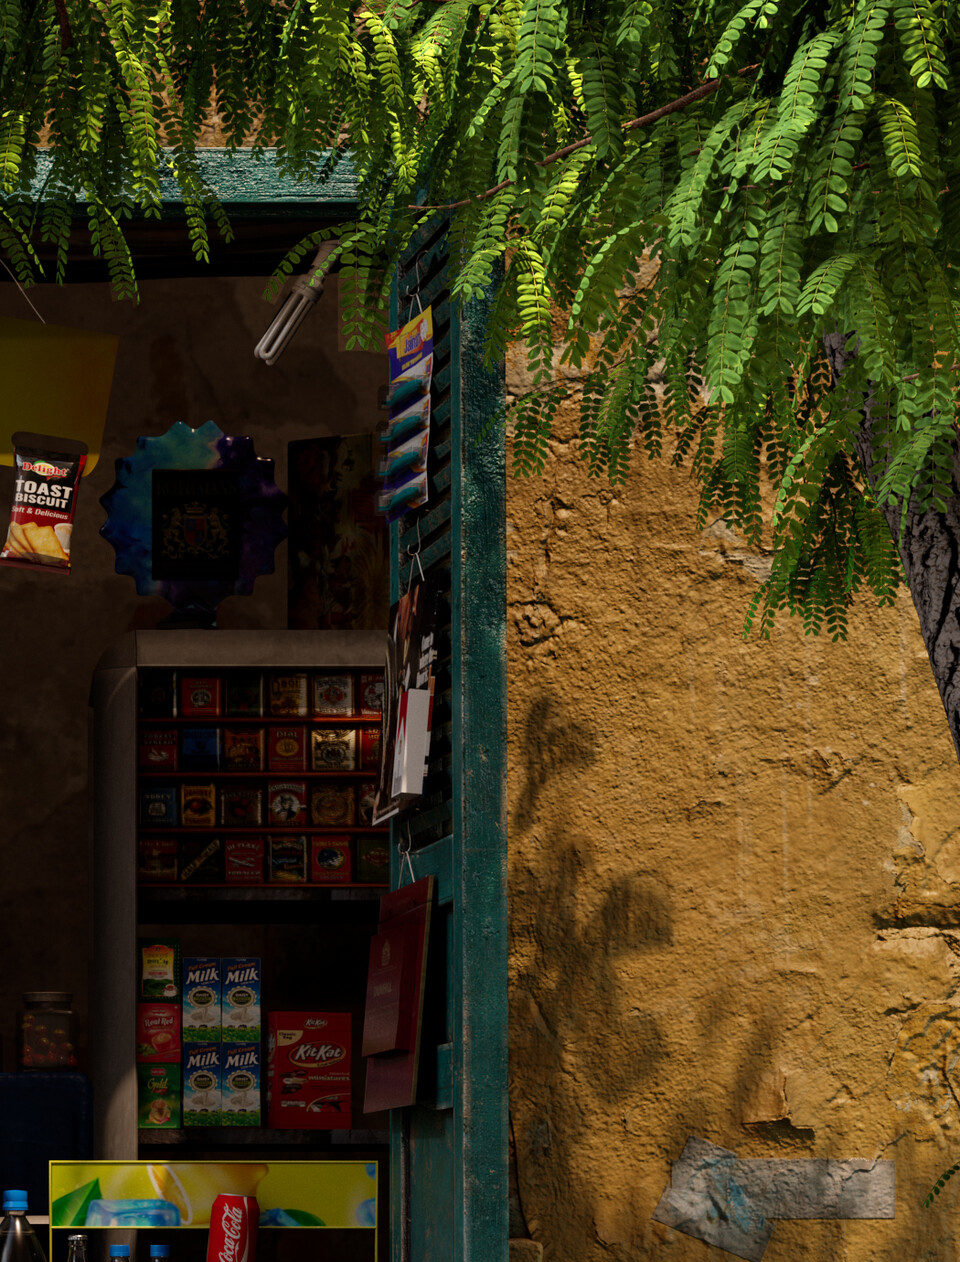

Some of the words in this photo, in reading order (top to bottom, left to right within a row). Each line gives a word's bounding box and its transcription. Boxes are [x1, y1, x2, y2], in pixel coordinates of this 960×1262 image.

[22, 462, 67, 476] Delight
[15, 479, 73, 500] TOAST
[15, 493, 68, 509] BISCUIT
[26, 507, 33, 515] &
[34, 508, 69, 520] Delicious
[276, 730, 299, 739] DIAL
[186, 968, 219, 985] Milk
[225, 968, 259, 985] Milk
[186, 1052, 220, 1069] Milk
[225, 1052, 259, 1069] Milk
[294, 1044, 342, 1061] KitKat
